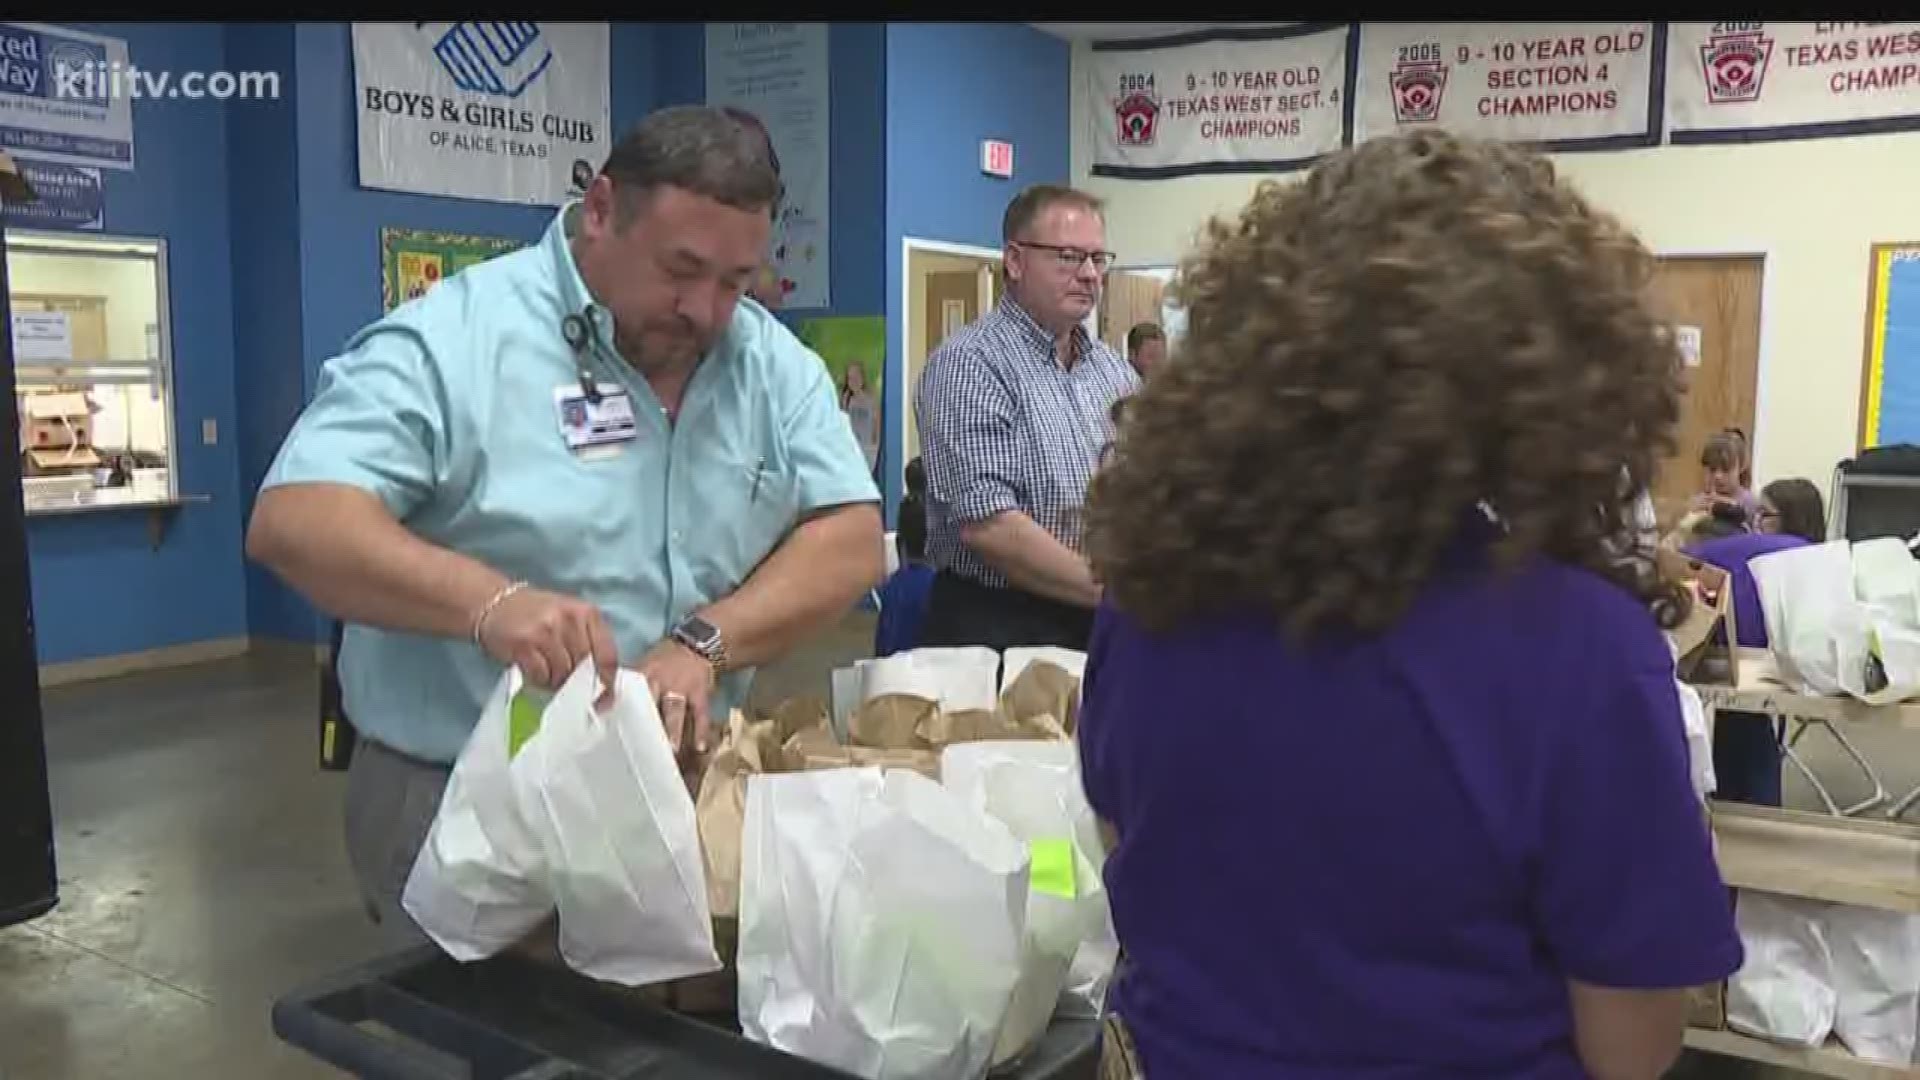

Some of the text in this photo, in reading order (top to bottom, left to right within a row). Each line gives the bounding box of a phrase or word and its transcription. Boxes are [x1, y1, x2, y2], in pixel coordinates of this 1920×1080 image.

[1398, 43, 1441, 61] 2005
[1456, 46, 1470, 64] 9
[1492, 43, 1515, 61] 10
[1523, 38, 1585, 60] YEAR
[1594, 31, 1645, 54] OLD
[1785, 40, 1860, 67] TEXAS
[1119, 73, 1155, 91] 2004
[1187, 73, 1197, 91] 9
[1212, 71, 1228, 88] 10
[1233, 71, 1278, 90] YEAR
[1282, 66, 1321, 87] OLD
[1487, 62, 1609, 90] SECTION 4
[366, 87, 595, 143] BOYS & GIRLS CLUB
[1168, 86, 1340, 119] TEXAS WEST SECT. 4
[1477, 91, 1618, 116] CHAMPIONS
[1201, 118, 1301, 139] CHAMPIONS
[430, 131, 548, 158] OF ALICE, TEXAS
